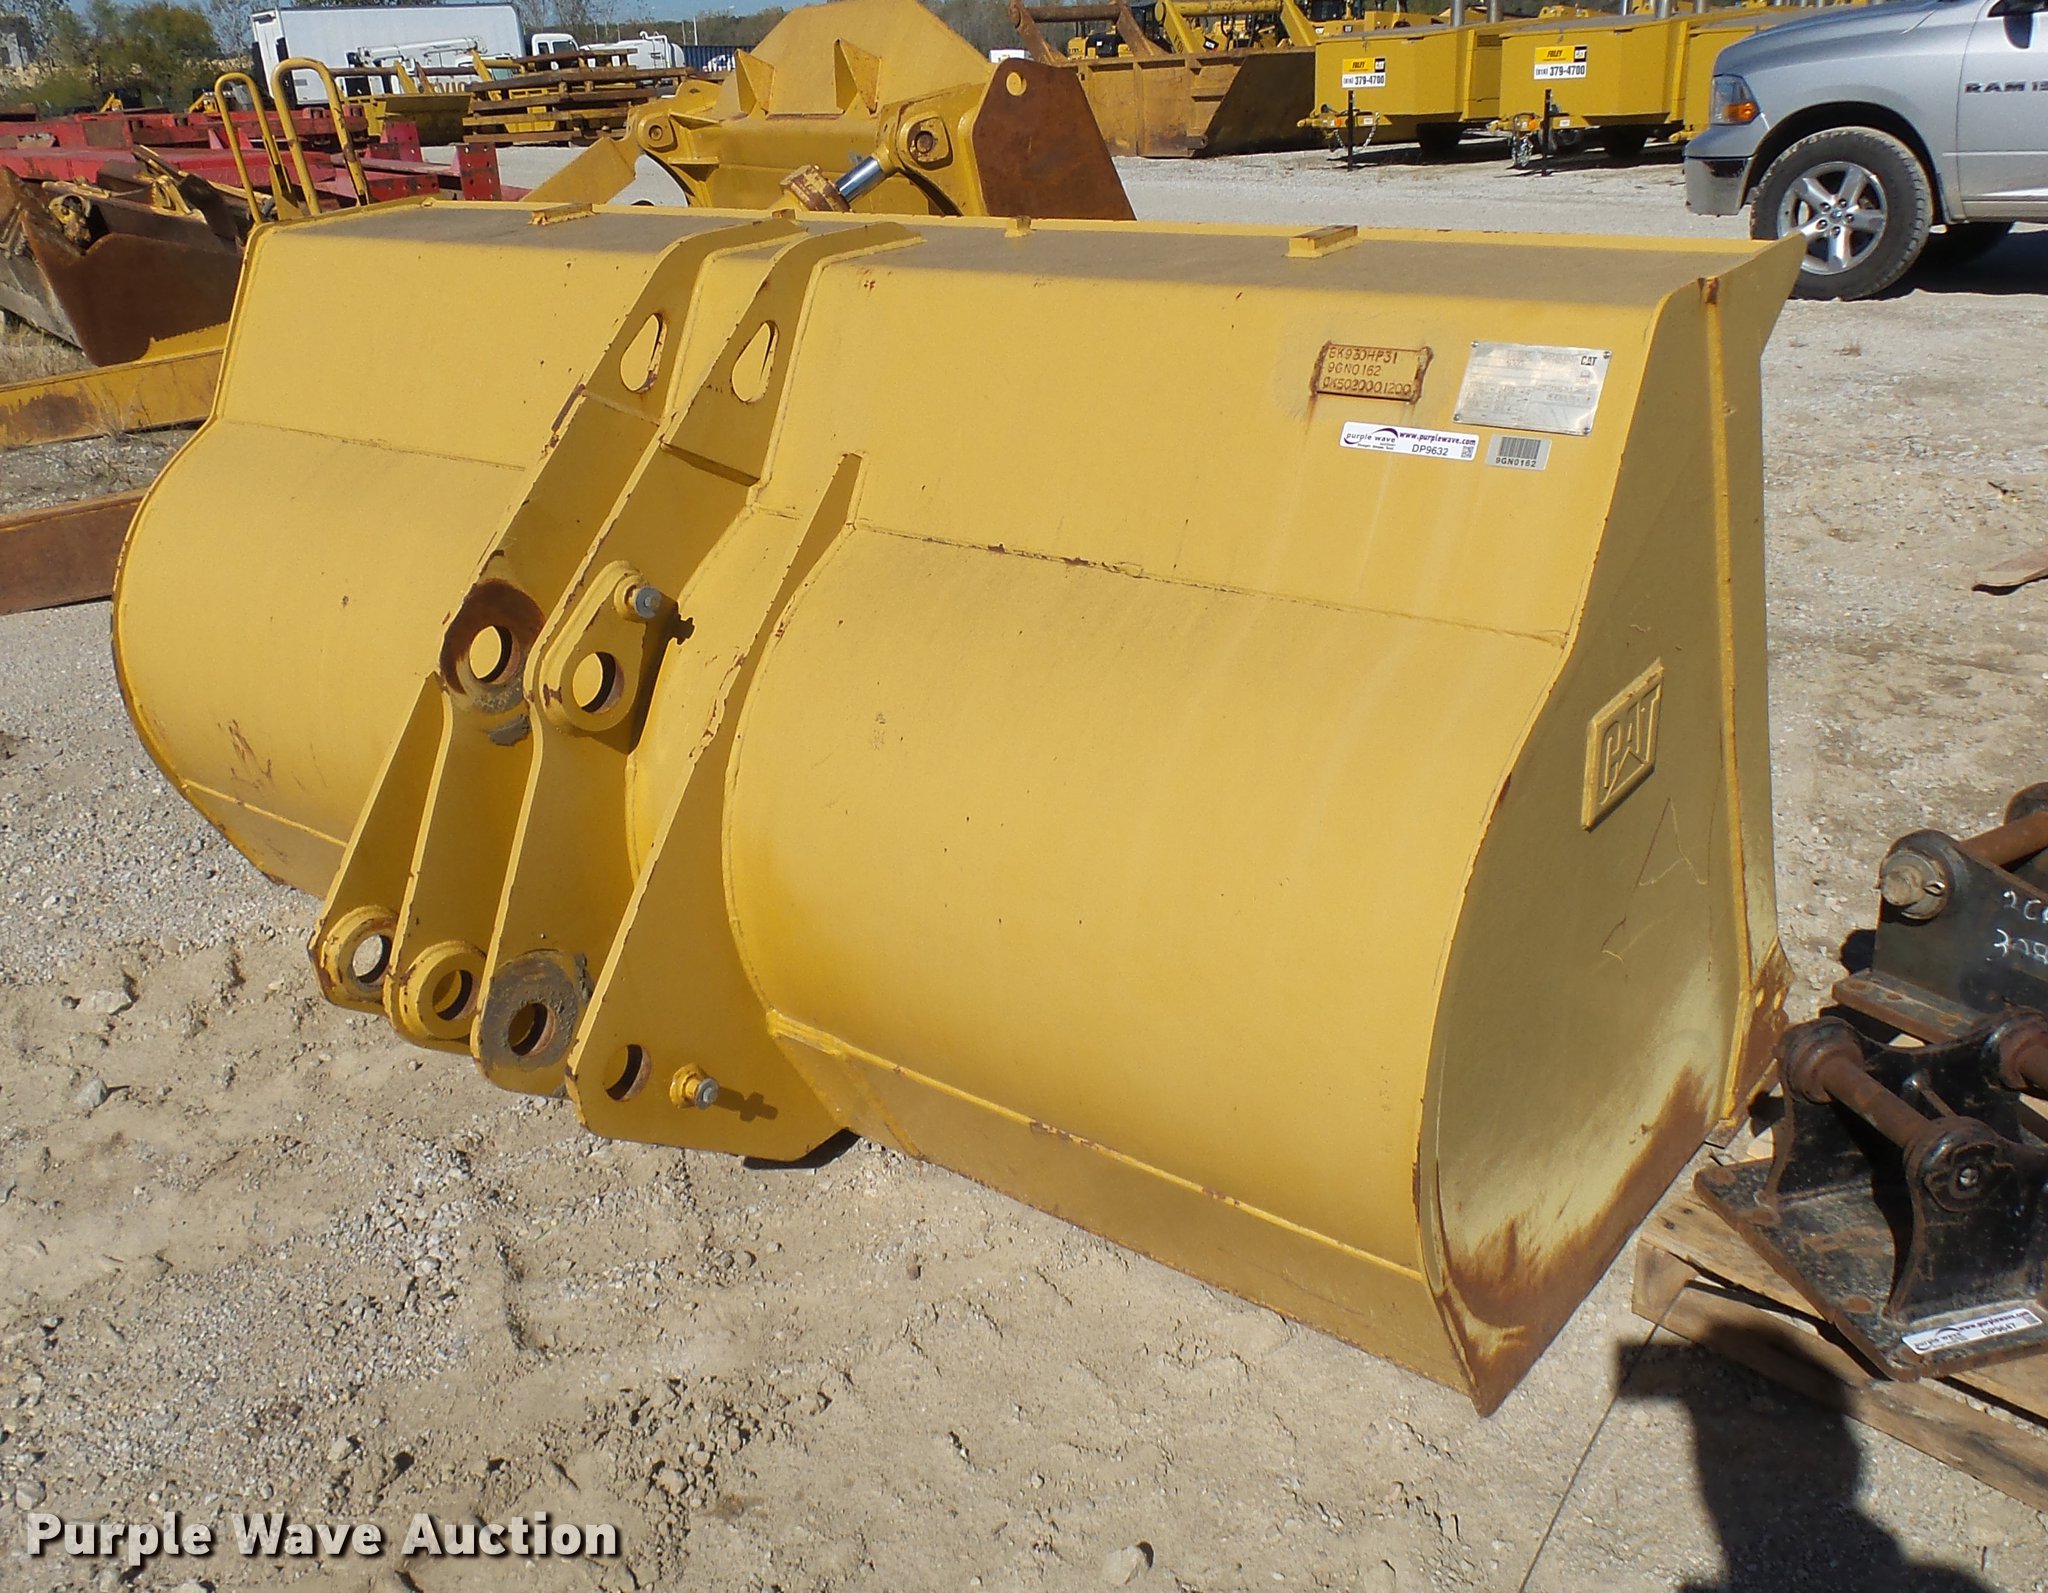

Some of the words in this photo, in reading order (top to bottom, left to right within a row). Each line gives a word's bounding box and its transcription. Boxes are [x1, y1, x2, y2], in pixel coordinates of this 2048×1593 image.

[1550, 65, 1585, 76] 379-4700
[1355, 75, 1385, 85] 379-4700
[1965, 82, 2026, 93] RAM
[1580, 355, 1598, 366] CAT
[1327, 361, 1382, 377] 9GN0162
[1346, 432, 1372, 443] purple
[1399, 431, 1476, 446] www.purplewave.com
[1411, 444, 1449, 456] DP9632
[1495, 457, 1537, 468] 9GN0162
